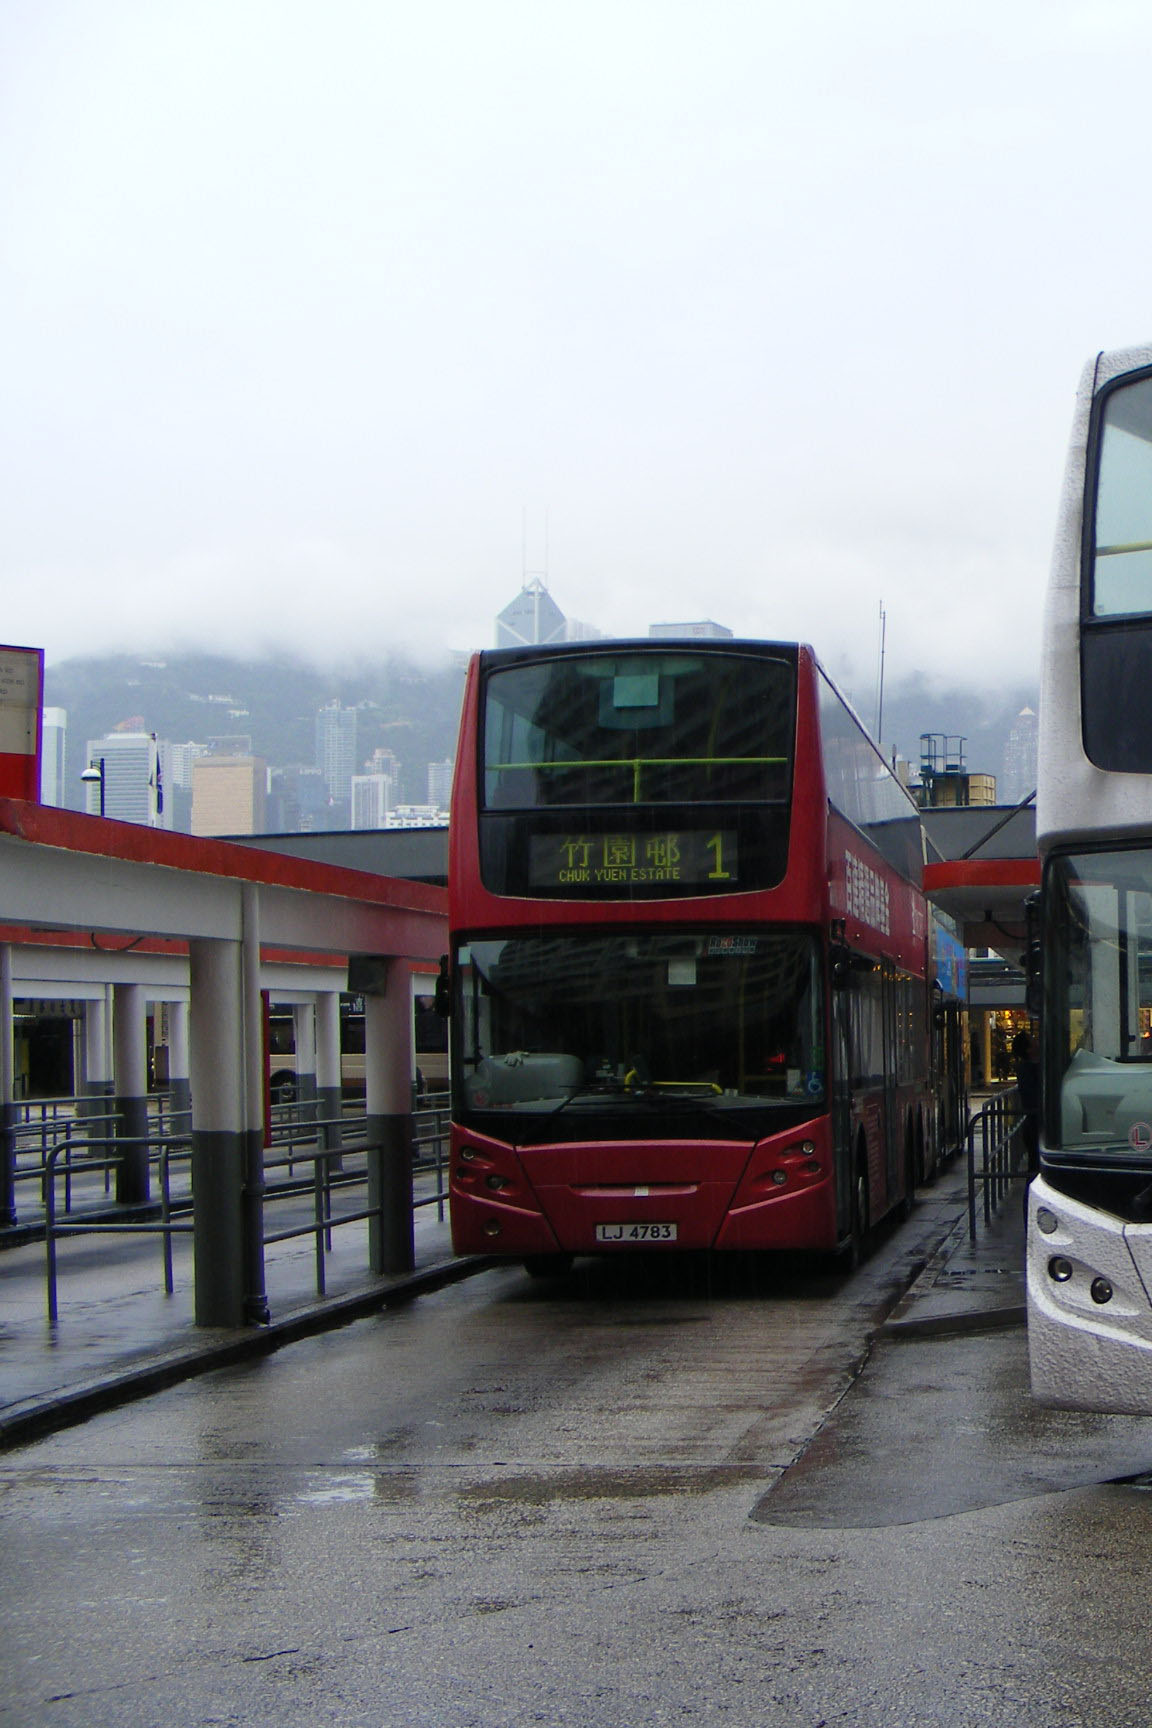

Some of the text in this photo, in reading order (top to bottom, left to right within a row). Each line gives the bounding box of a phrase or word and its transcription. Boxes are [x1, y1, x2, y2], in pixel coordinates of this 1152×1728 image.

[560, 834, 681, 868] 竹園邨
[706, 832, 730, 879] 1
[559, 867, 681, 882] CHUK YUEN ESTATE
[602, 1225, 671, 1239] LJ 4783
